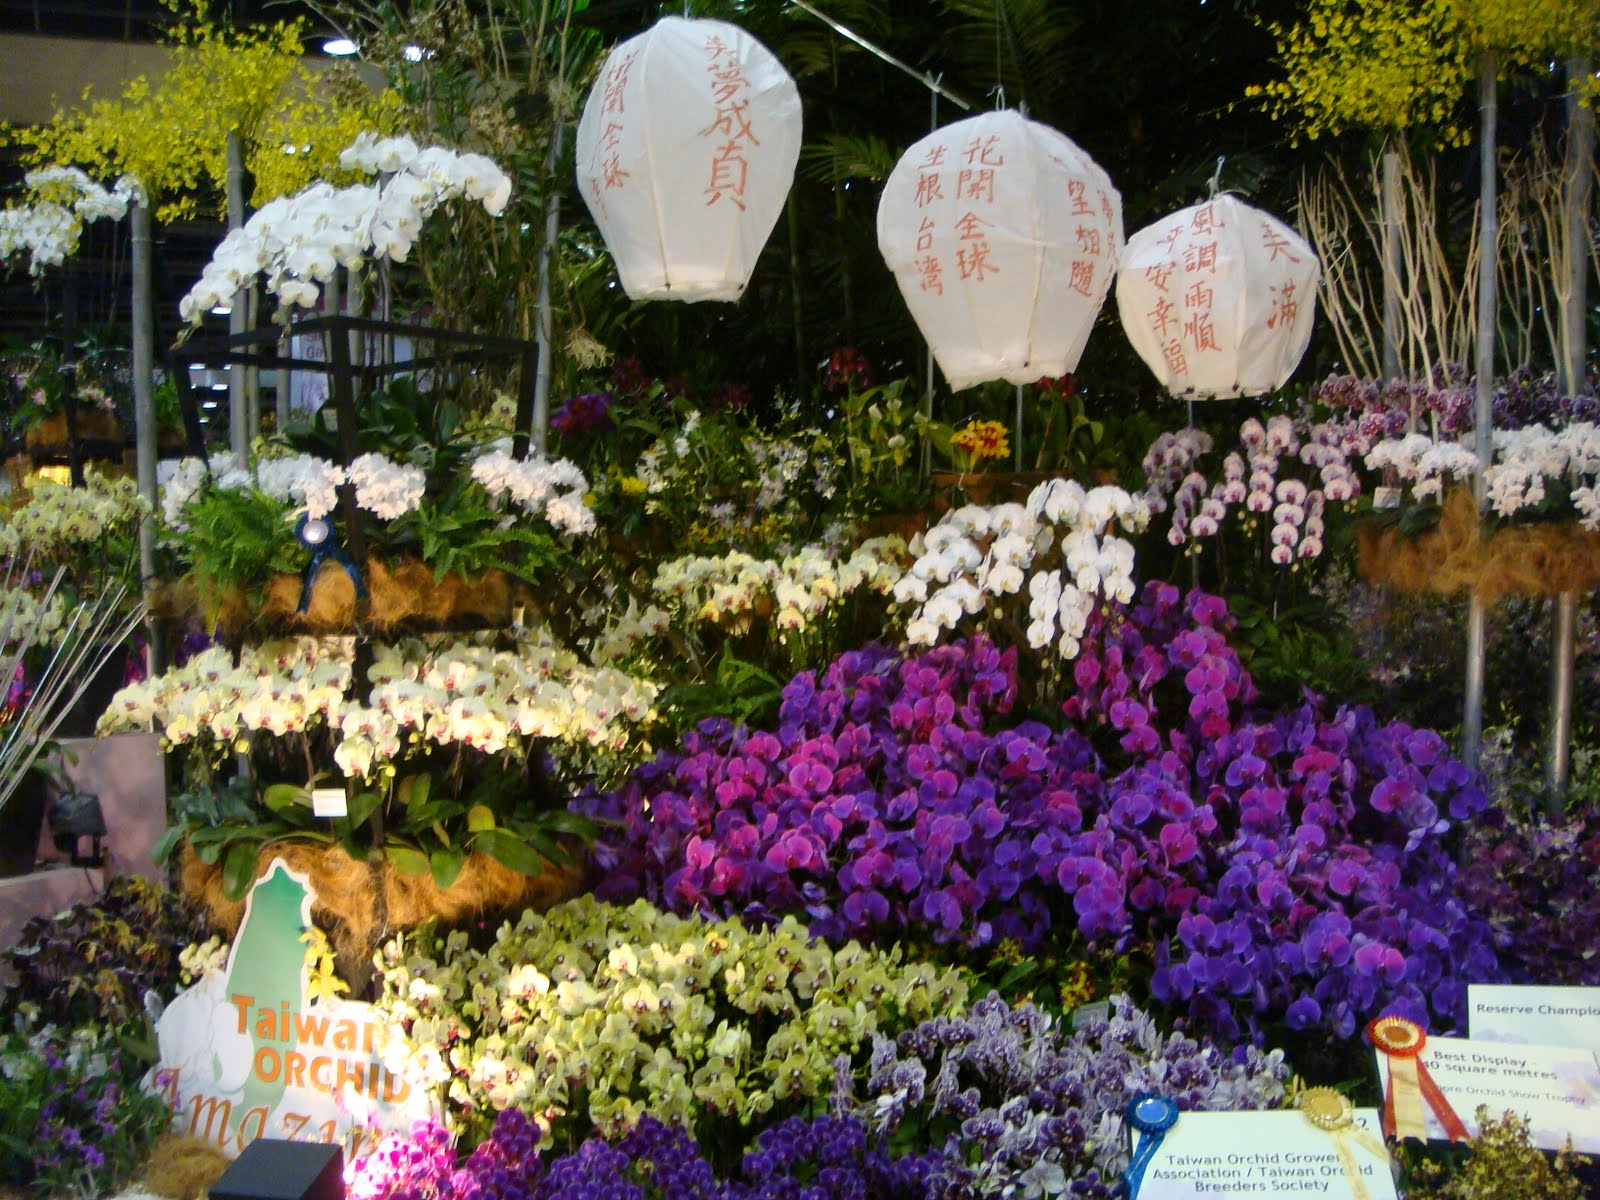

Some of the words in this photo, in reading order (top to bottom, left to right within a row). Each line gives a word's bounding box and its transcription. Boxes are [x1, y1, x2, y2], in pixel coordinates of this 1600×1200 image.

[913, 146, 948, 297] 生根台灣
[954, 135, 1004, 282] 花開全球
[1182, 204, 1224, 352] 風調雨順
[1145, 225, 1189, 376] 平安幸福
[231, 993, 391, 1053] Taiwan
[1476, 1003, 1533, 1015] Reserve
[254, 1047, 411, 1104] ORCHID
[1434, 1051, 1466, 1062] Best
[1472, 1054, 1526, 1069] Display
[1445, 1063, 1497, 1075] square
[1503, 1068, 1558, 1080] metres
[1153, 1167, 1241, 1179] Association
[1260, 1166, 1315, 1177] Taiwan
[1320, 1164, 1373, 1176] Orcid
[1166, 1154, 1222, 1166] Taiwan
[1228, 1153, 1280, 1165] Orchid
[1195, 1181, 1266, 1193] Breeders
[1271, 1180, 1329, 1193] Society
